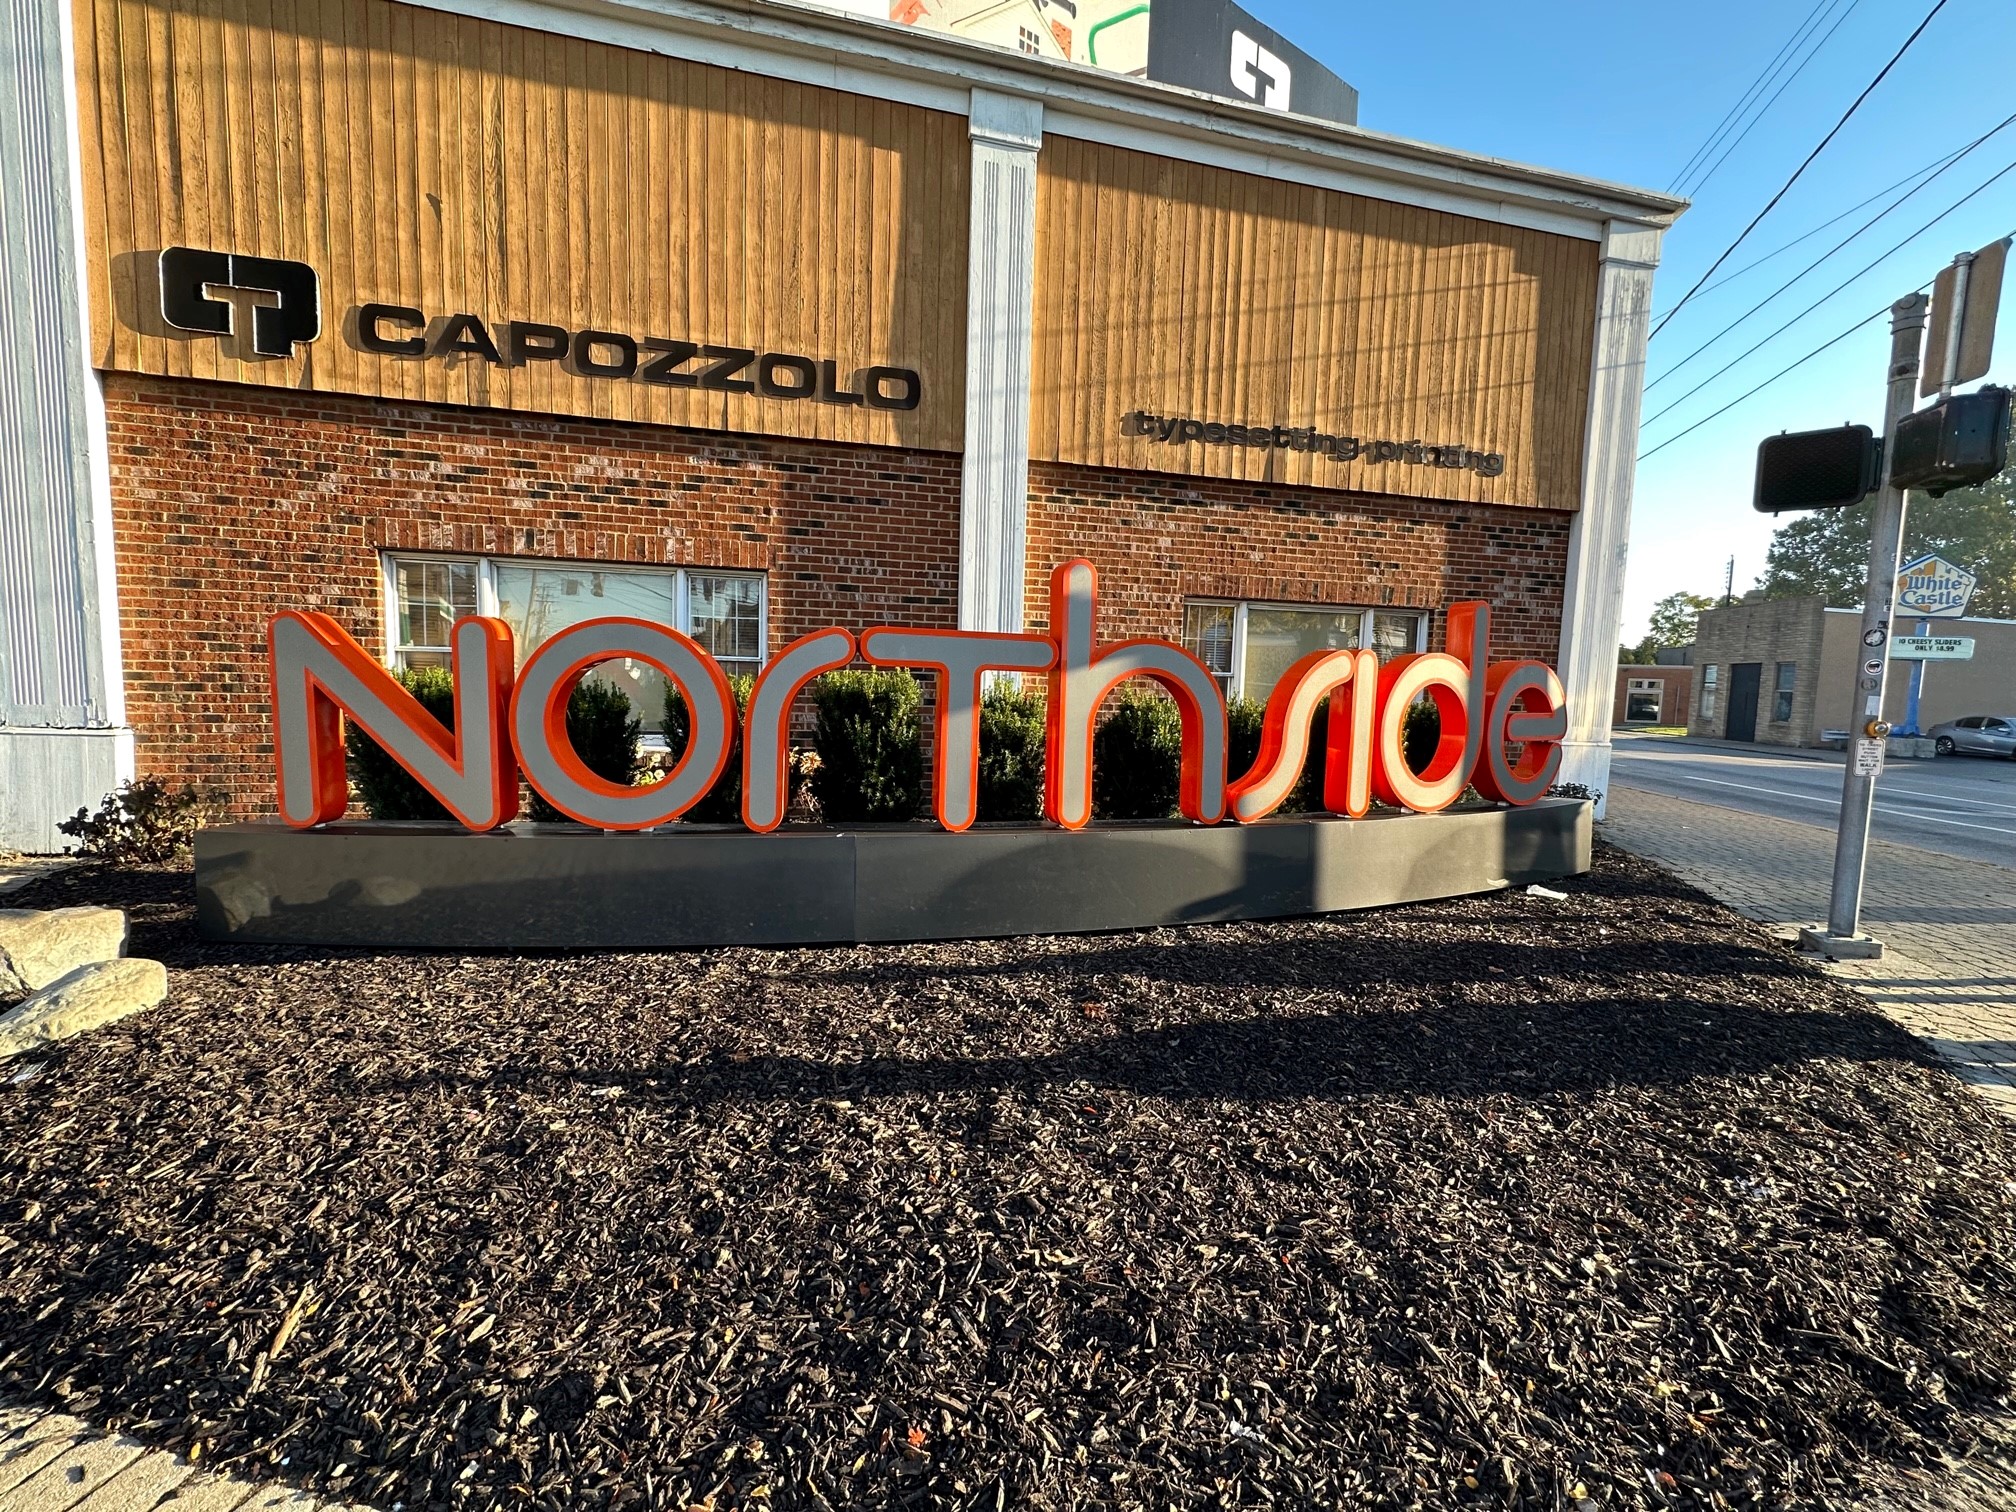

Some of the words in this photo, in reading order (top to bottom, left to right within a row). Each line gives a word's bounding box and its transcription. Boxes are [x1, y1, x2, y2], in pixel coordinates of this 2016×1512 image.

[358, 302, 920, 410] CAPOZZOLO
[1907, 576, 1962, 592] White
[1900, 590, 1963, 605] Castle
[1907, 638, 1933, 646] CHEESY
